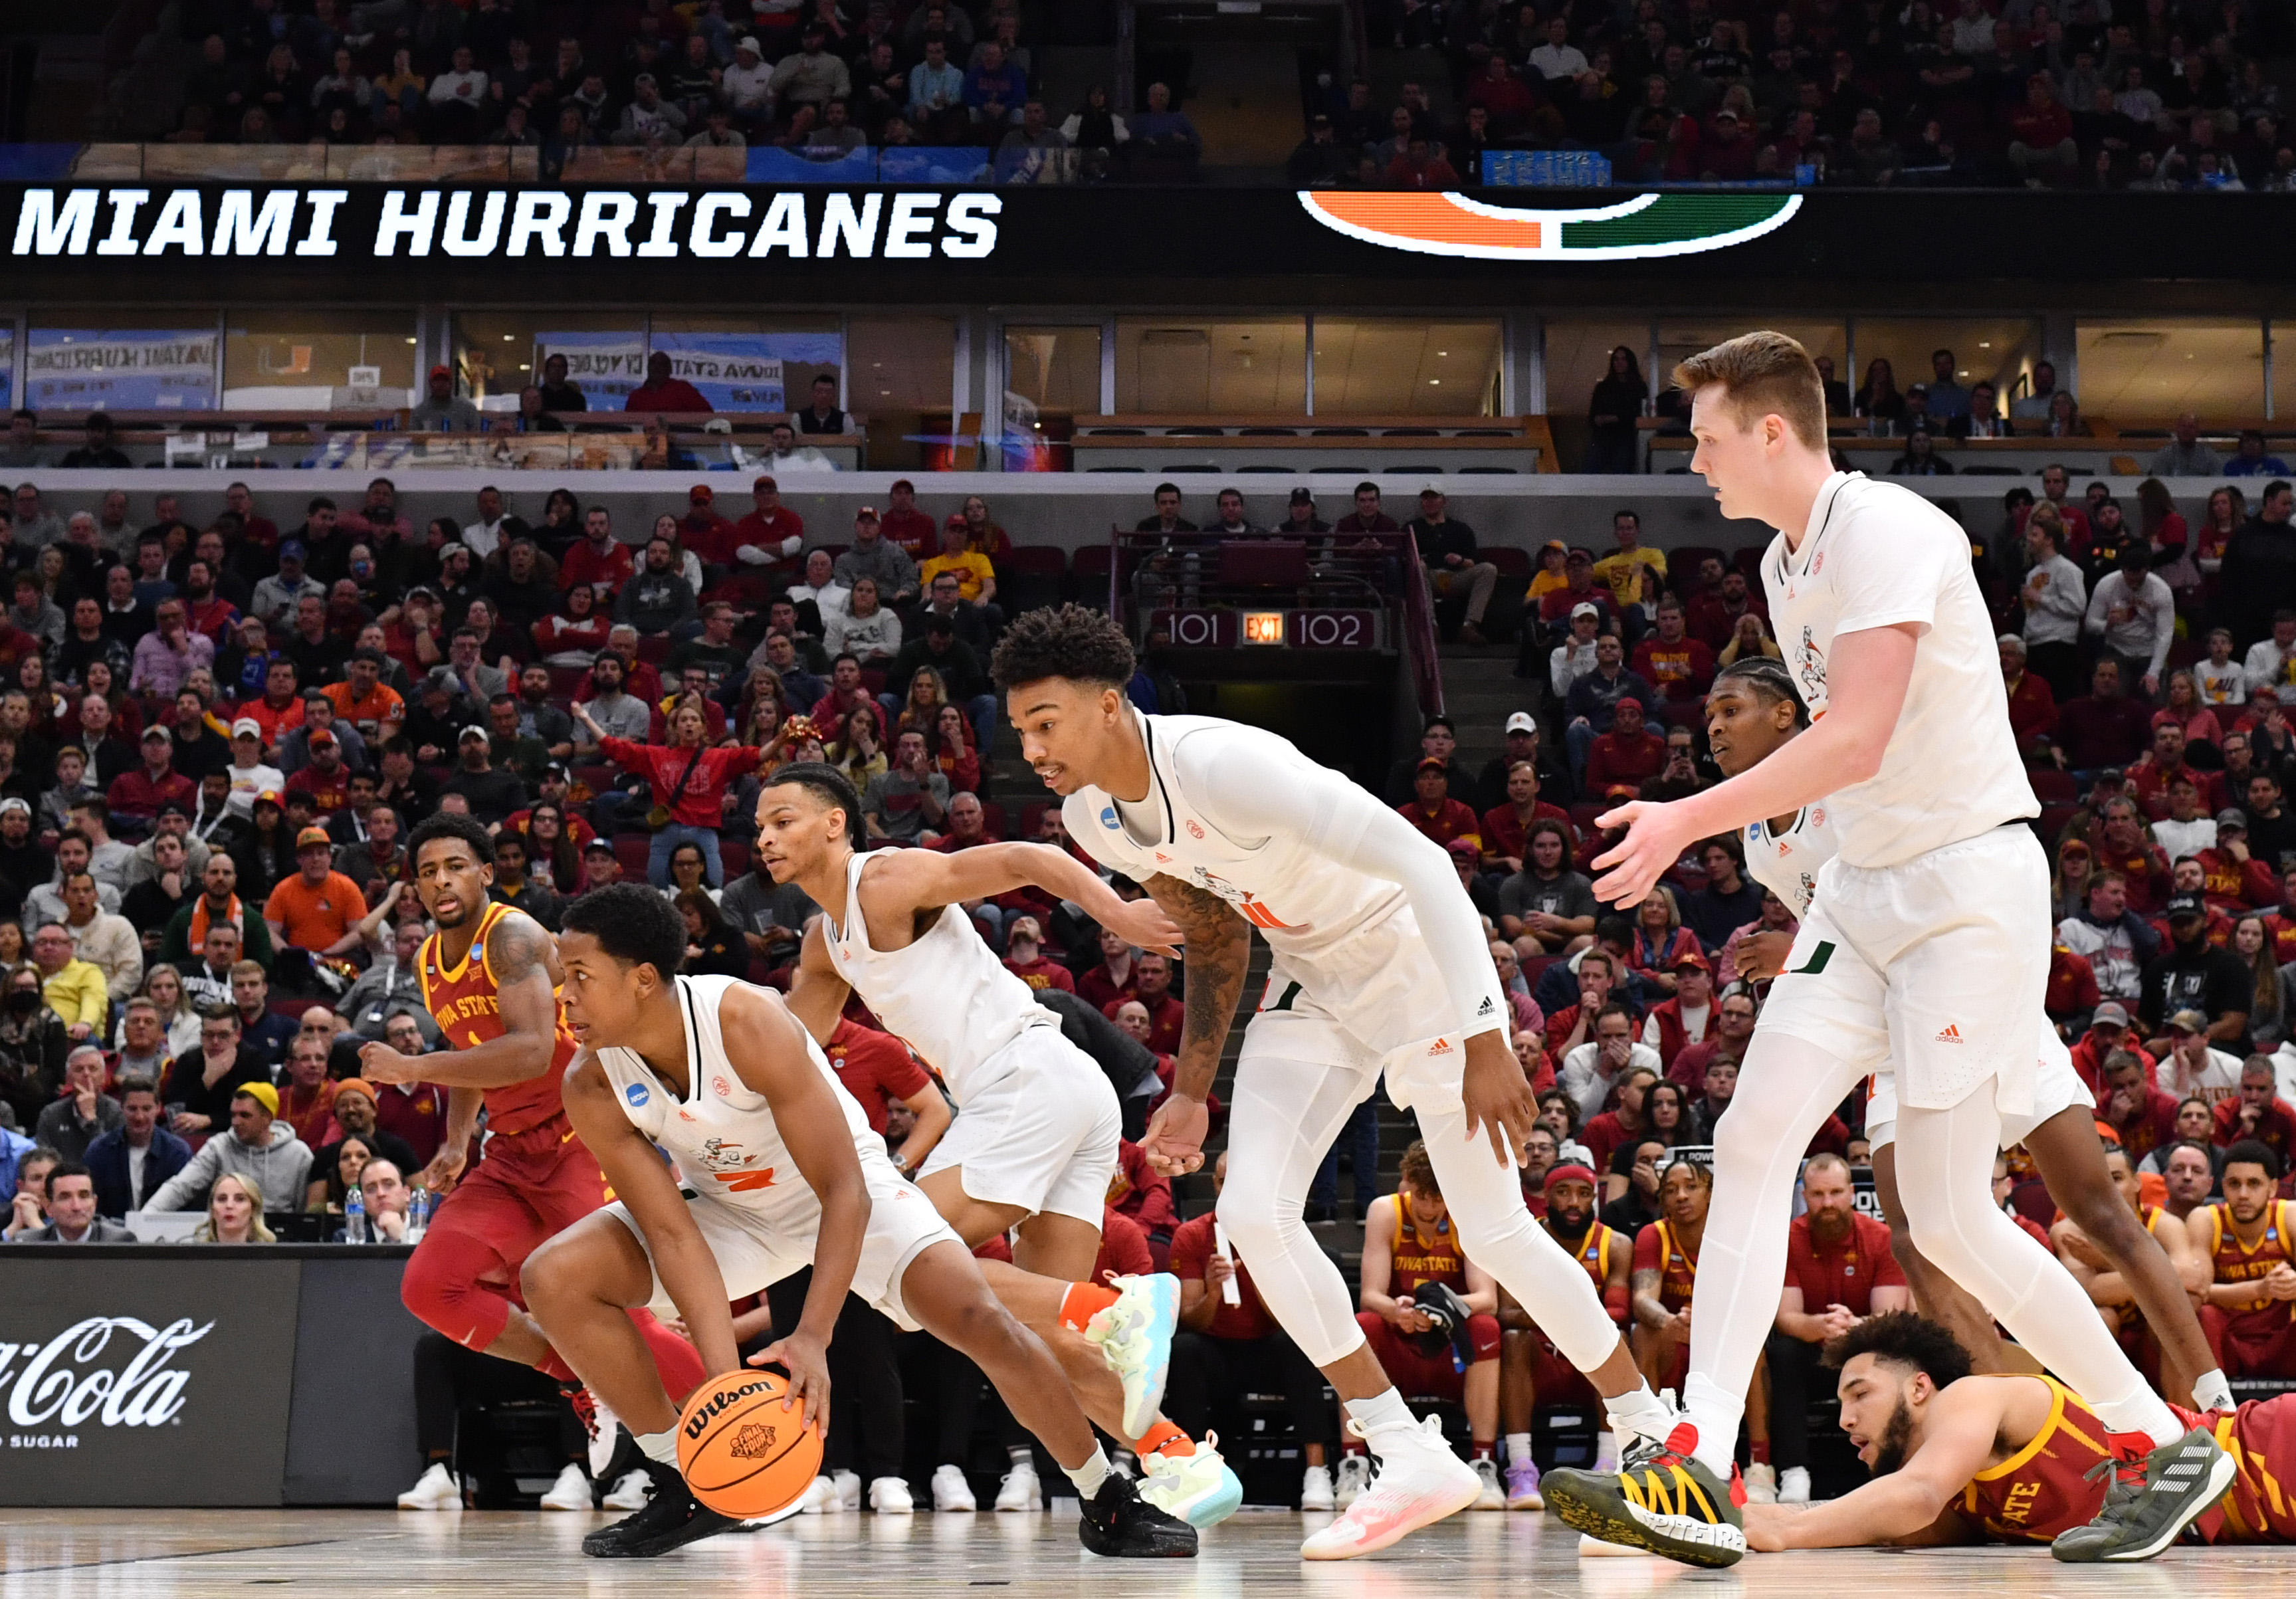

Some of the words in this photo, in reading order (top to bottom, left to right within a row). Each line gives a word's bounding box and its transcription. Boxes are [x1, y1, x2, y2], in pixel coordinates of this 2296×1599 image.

[12, 189, 348, 256] MIAMI
[373, 191, 1003, 258] HURRICANES
[1168, 613, 1217, 644] 101
[1246, 617, 1279, 640] EXIT
[1299, 614, 1360, 645] 102
[1934, 1035, 1964, 1045] adidas
[1427, 1047, 1454, 1057] adidas
[630, 1090, 649, 1104] NCAA
[684, 1380, 776, 1440] Wilson
[10, 1435, 79, 1447] SUGAR
[739, 1422, 765, 1445] FINAL
[742, 1432, 767, 1455] FOUR
[2002, 1482, 2041, 1526] ATE
